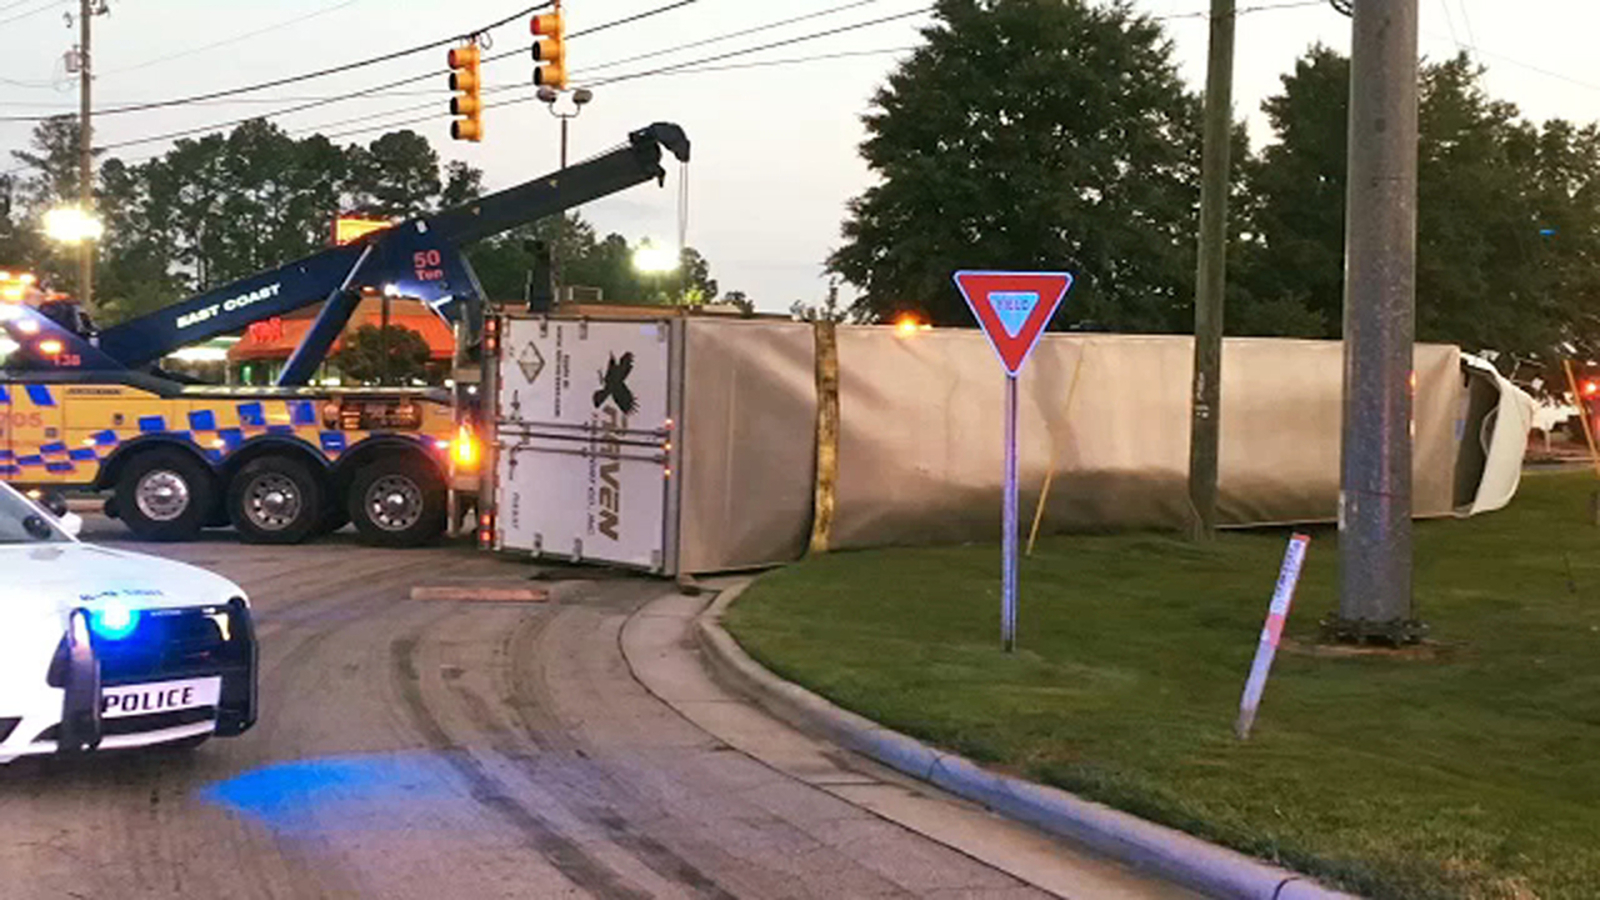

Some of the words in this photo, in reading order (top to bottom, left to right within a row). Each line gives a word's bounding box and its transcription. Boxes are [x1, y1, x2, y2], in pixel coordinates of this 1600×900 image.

[413, 250, 441, 268] 50
[415, 269, 443, 280] Ton
[176, 304, 220, 329] EAST
[223, 282, 281, 311] COAST
[101, 687, 195, 713] POLICE
